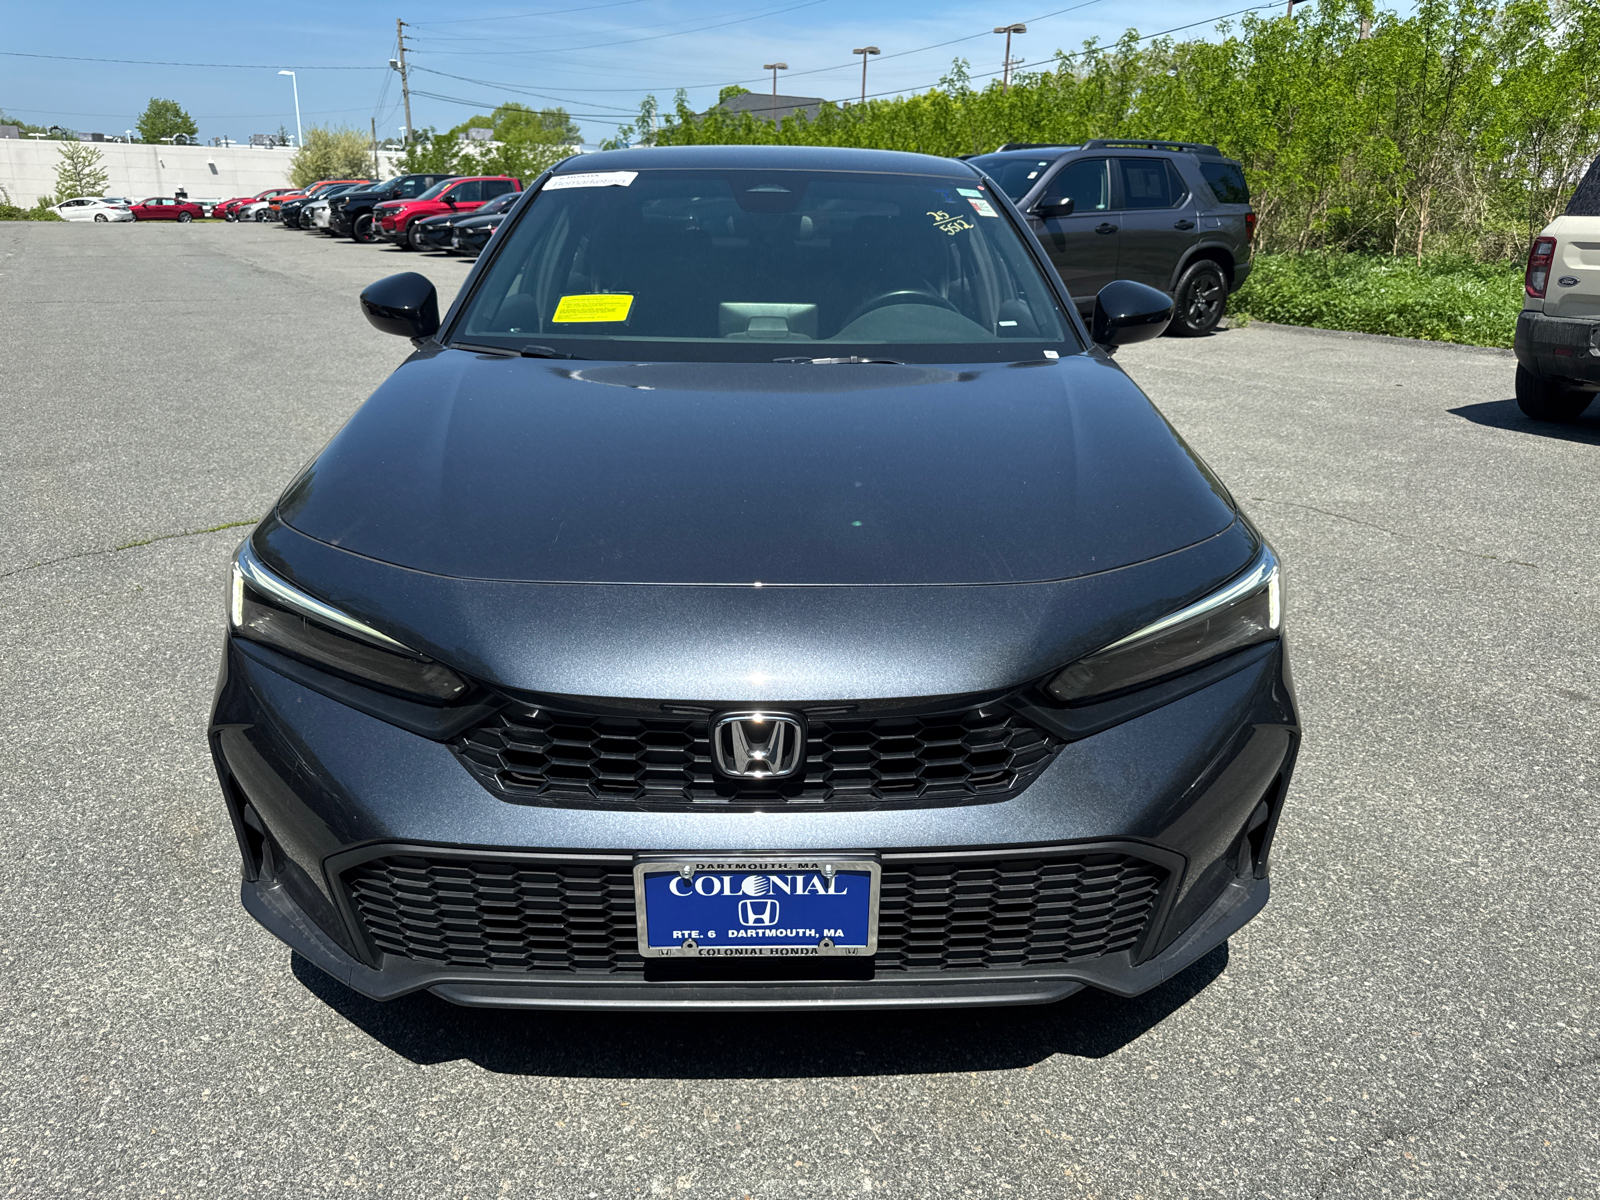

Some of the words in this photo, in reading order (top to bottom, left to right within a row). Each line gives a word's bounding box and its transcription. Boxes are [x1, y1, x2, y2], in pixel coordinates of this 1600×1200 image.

[926, 210, 950, 221] 25
[797, 862, 819, 870] MA
[669, 874, 848, 897] COLONIAL
[672, 930, 704, 939] RTE.
[707, 930, 717, 938] 6
[728, 928, 820, 939] DARTMOUTH,
[823, 928, 845, 938] MA
[698, 948, 764, 957] COLONIAL
[770, 947, 819, 956] HONDA
